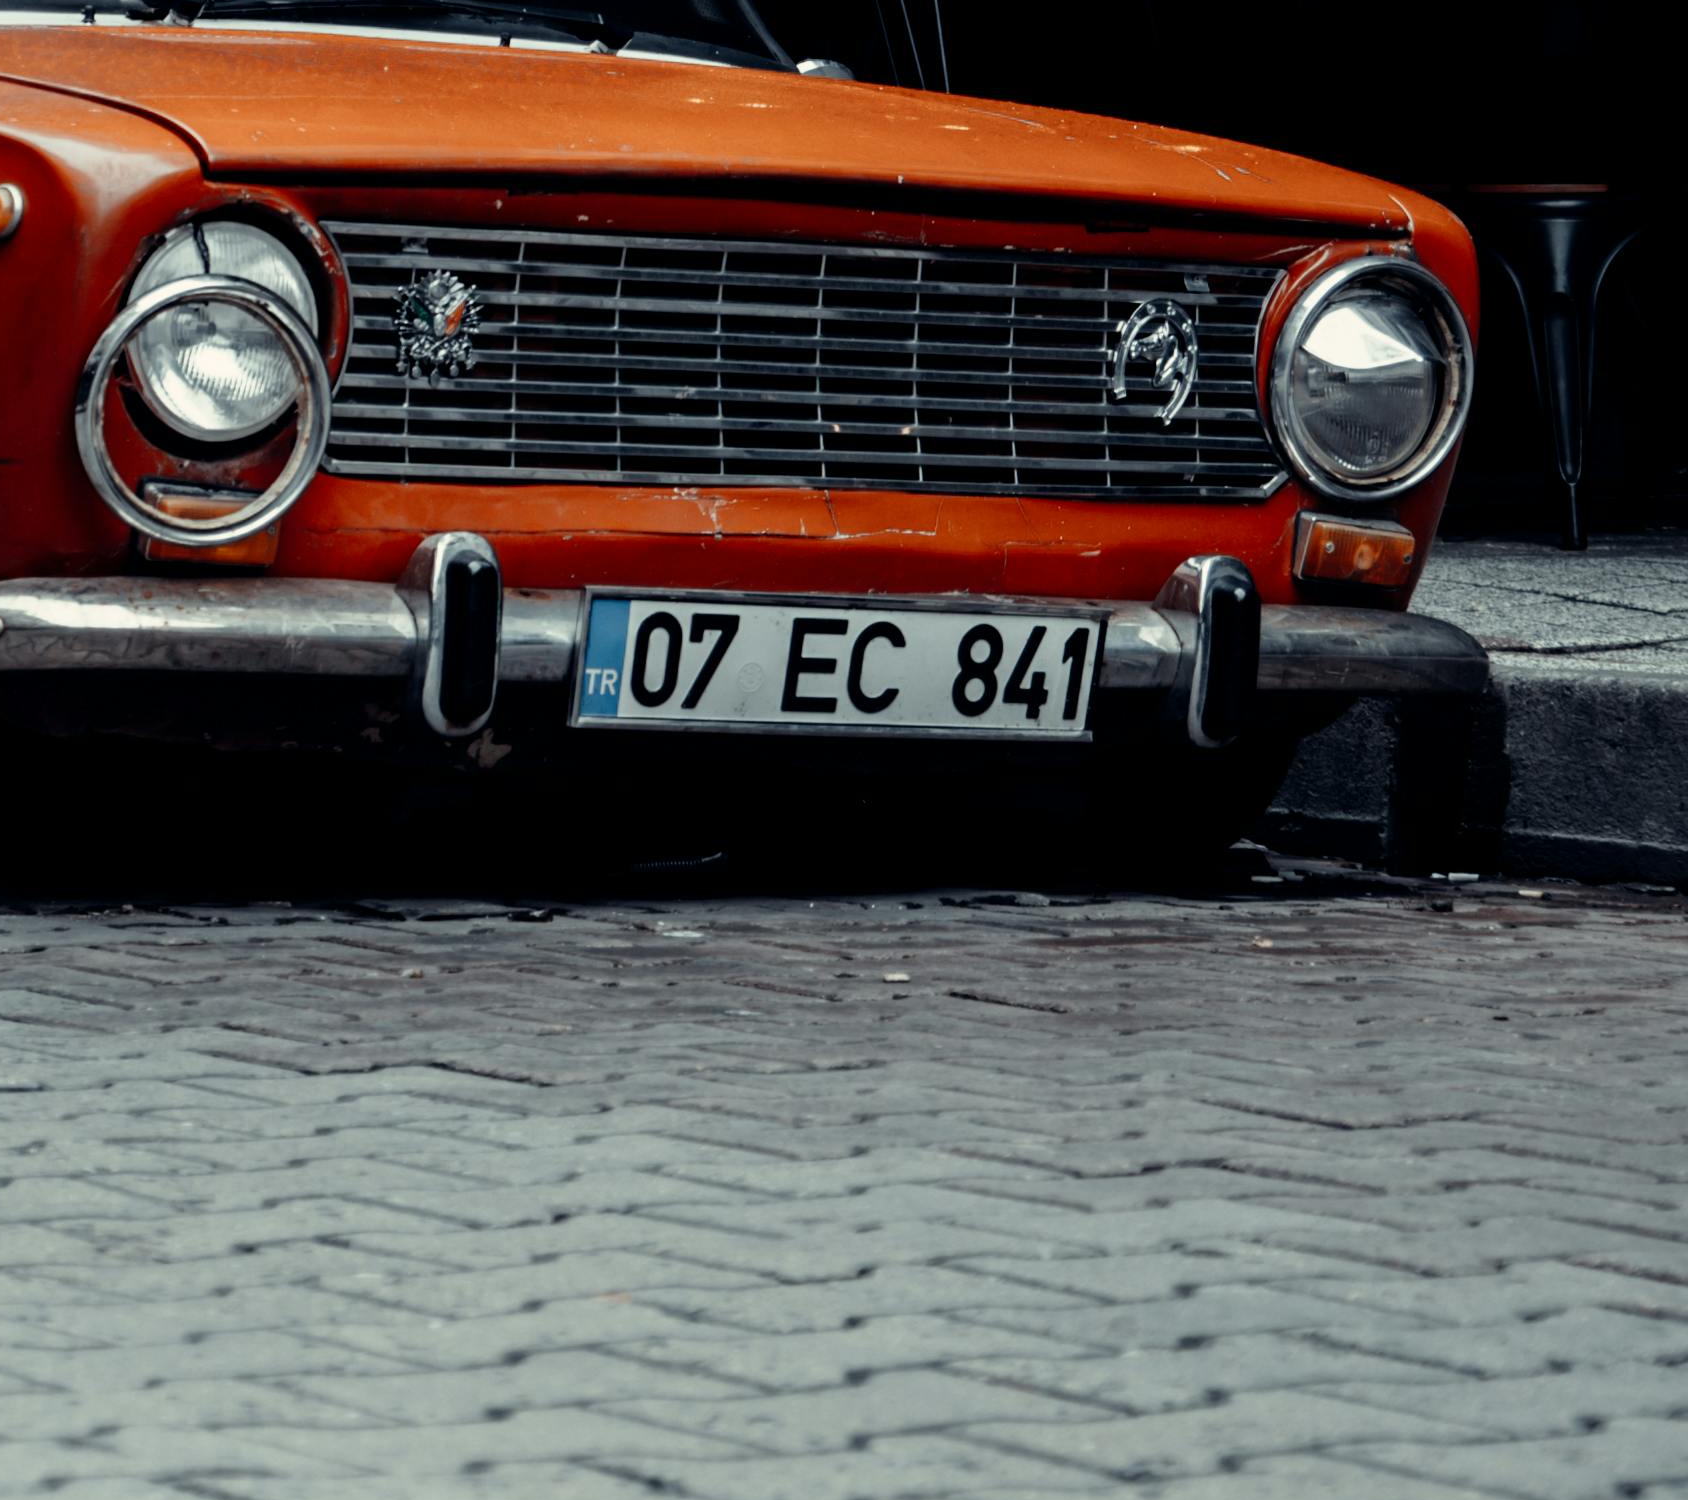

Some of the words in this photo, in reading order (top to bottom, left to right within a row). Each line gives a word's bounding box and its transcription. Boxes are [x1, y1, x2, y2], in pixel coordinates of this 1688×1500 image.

[585, 668, 619, 696] TR
[630, 610, 740, 710] 07
[780, 617, 906, 714] EC
[951, 623, 1090, 720] 841
